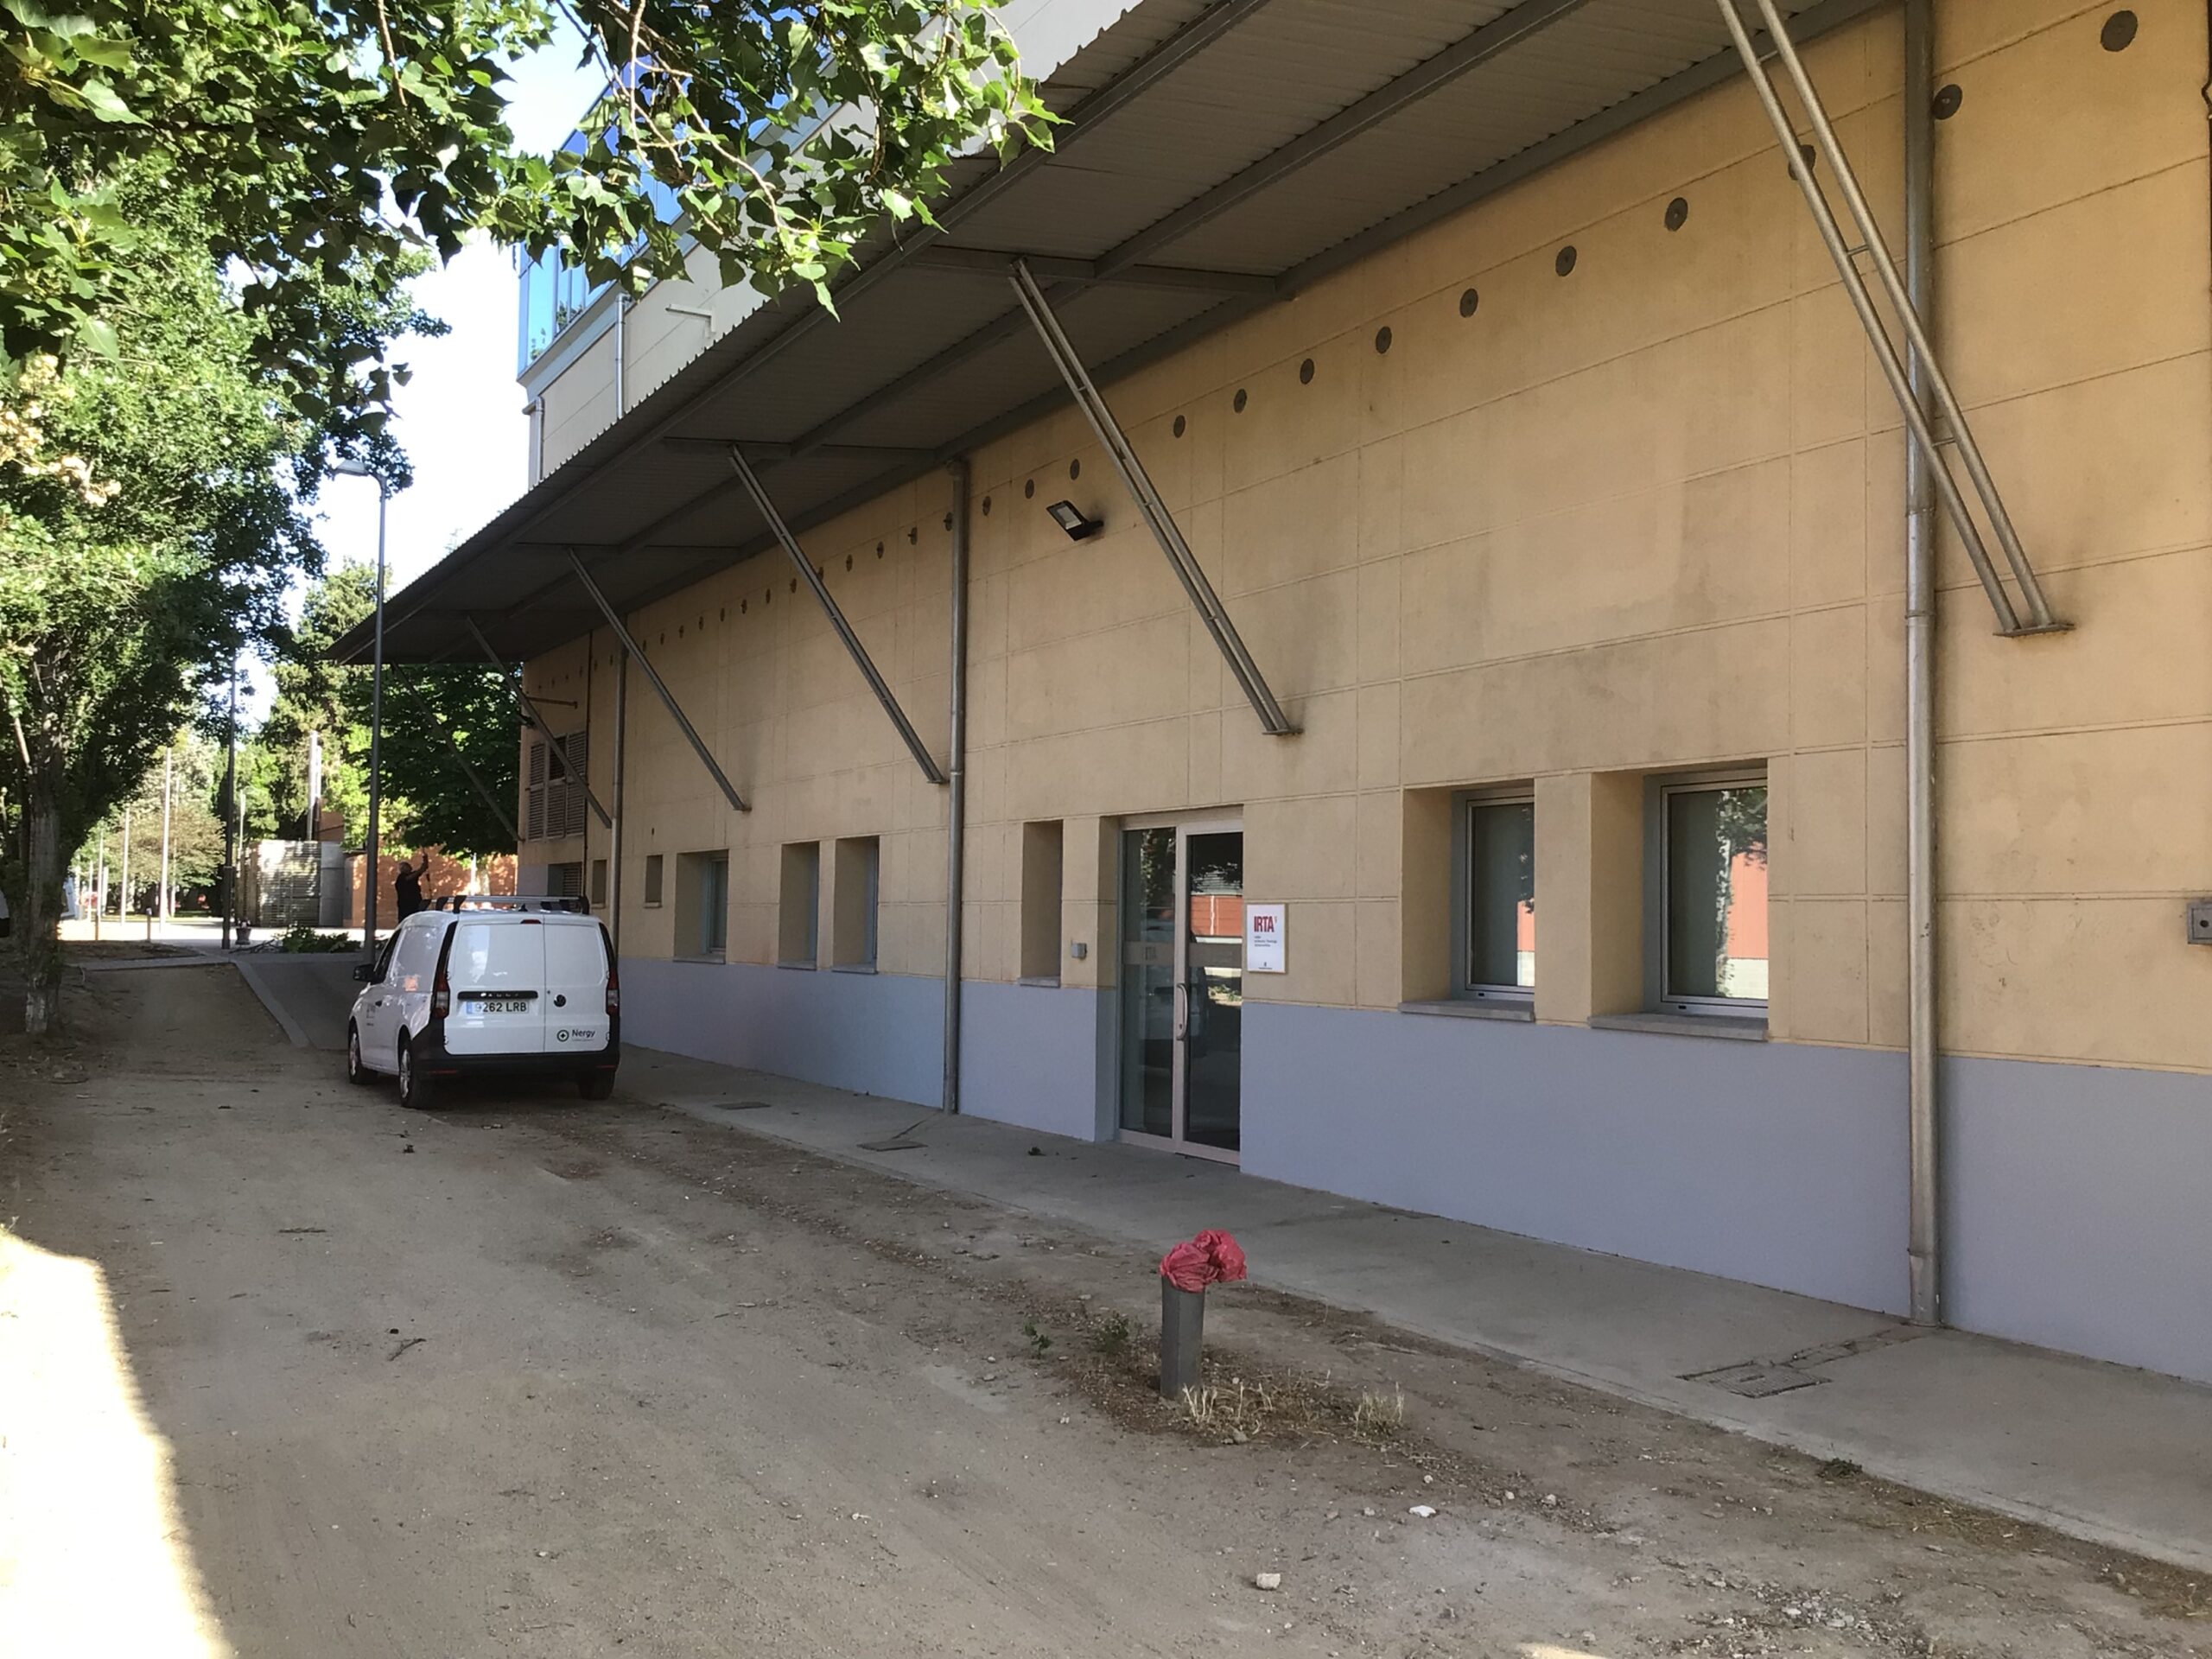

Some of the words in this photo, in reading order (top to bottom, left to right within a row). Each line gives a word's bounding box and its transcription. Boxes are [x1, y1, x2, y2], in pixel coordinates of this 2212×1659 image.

[1254, 916, 1274, 932] IRTA
[505, 1002, 526, 1012] LRB
[572, 1029, 595, 1038] Nergy
